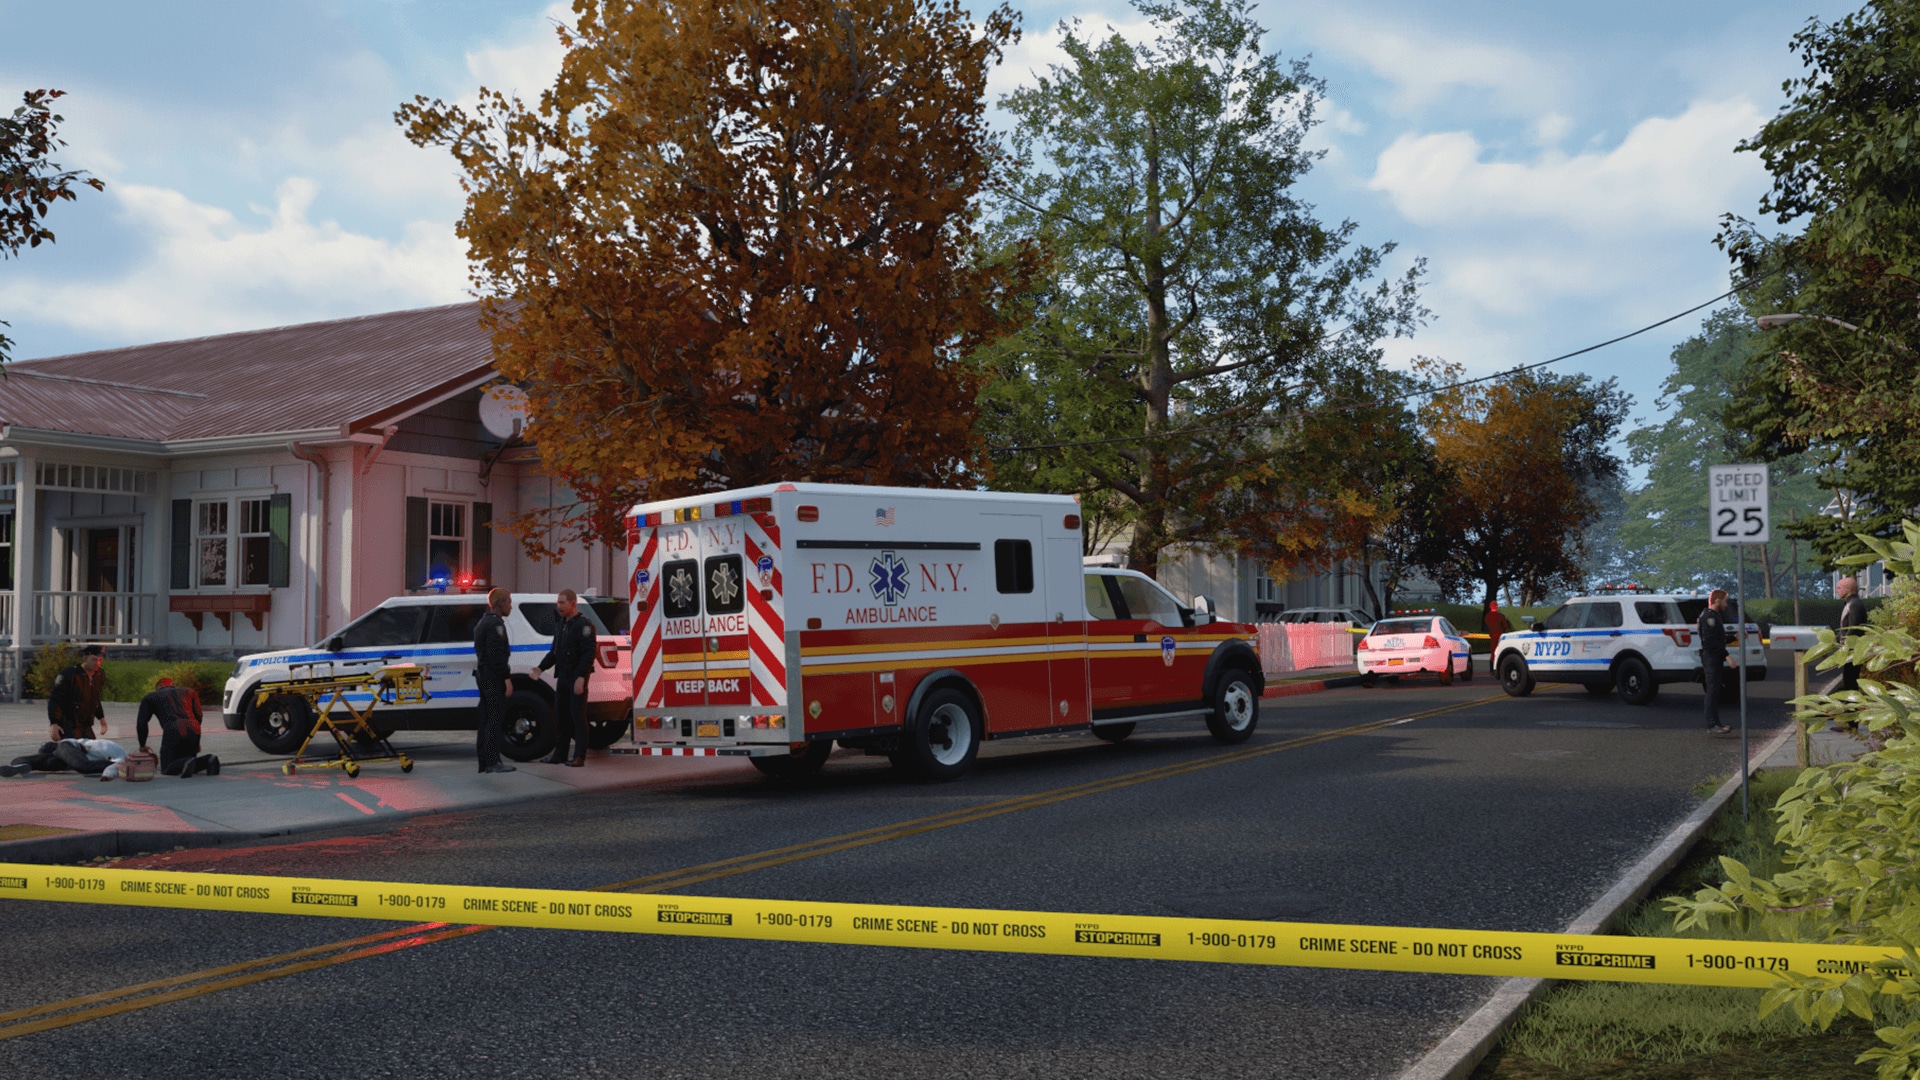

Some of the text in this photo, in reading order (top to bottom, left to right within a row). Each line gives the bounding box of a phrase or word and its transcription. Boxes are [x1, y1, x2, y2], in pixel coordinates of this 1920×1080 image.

[1715, 473, 1763, 487] SPEED
[1719, 488, 1757, 502] LIMIT
[1717, 508, 1764, 537] 25
[665, 523, 740, 552] F.D. N.Y.
[810, 563, 967, 594] F.D. N.Y.
[845, 606, 938, 624] AMBULANCE
[1534, 641, 1571, 656] NYPD
[258, 655, 289, 666] POLICE
[675, 679, 740, 694] KEEP BACK
[0, 877, 25, 888] RIME
[45, 877, 105, 891] 1-900-0179
[121, 880, 152, 893] CRIME
[155, 882, 187, 895] SCENE
[197, 885, 211, 897] DO
[213, 885, 233, 897] NOT
[236, 886, 270, 899] CROSS
[294, 893, 355, 906] STOPCRIME
[378, 894, 446, 909] 1-900-0179
[463, 898, 499, 911] CRIME
[502, 900, 538, 913] SCENE
[549, 902, 565, 915] DO
[568, 904, 591, 916] NOT
[594, 905, 632, 918] CROSS
[660, 911, 730, 925] STOPCRIME
[755, 912, 833, 928] 1-900-0179
[853, 917, 893, 931] CRIME
[897, 919, 938, 933] SCENE
[951, 921, 969, 935] DO
[973, 923, 999, 936] NOT
[1003, 924, 1046, 938] CROSS
[1079, 931, 1158, 945] STOPCRIME
[1188, 932, 1276, 949] 1-900-0179
[1299, 937, 1346, 952] CRIME
[1350, 939, 1398, 955] SCENE
[1413, 942, 1433, 956] DO
[1438, 943, 1468, 957] NOT
[1472, 945, 1522, 960] CROSS
[1560, 953, 1652, 968] STOPCRIME
[1686, 954, 1789, 971] 1-900-0179
